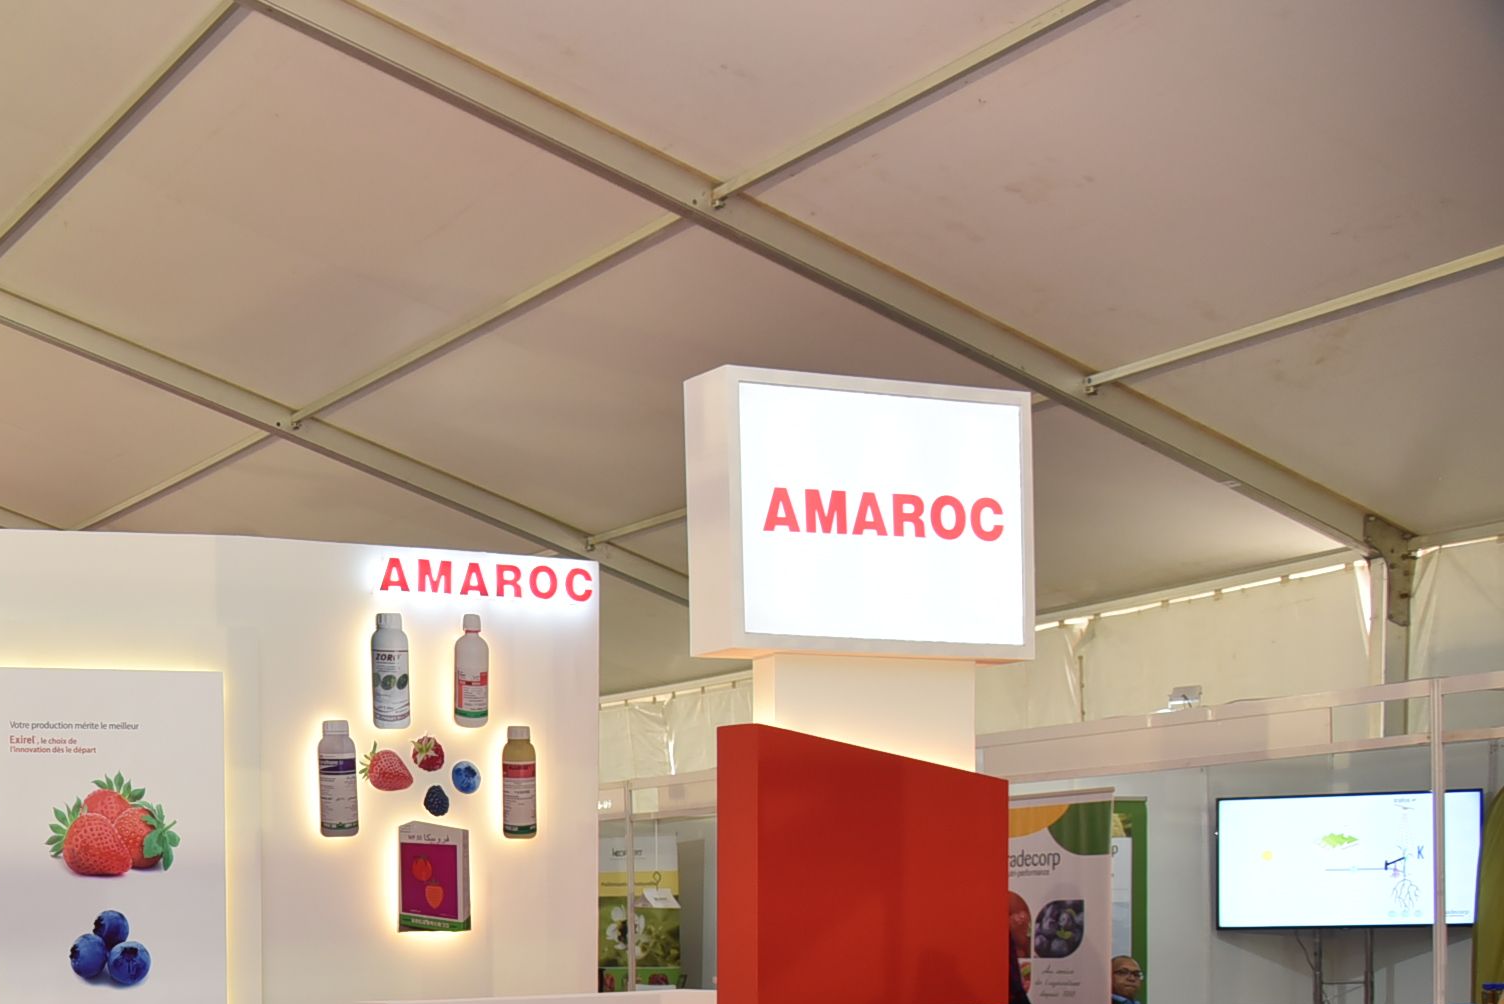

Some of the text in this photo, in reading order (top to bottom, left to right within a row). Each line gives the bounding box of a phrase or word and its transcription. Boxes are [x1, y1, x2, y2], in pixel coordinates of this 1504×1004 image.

[763, 487, 1004, 542] AMAROC
[380, 556, 594, 603] AMAROC
[376, 653, 401, 662] ZOR
[9, 720, 139, 731] Votre production mérite le meilleur
[48, 737, 67, 745] choix
[68, 737, 77, 745] de
[9, 745, 51, 754] l'innovation
[52, 746, 64, 754] dès
[73, 746, 97, 755] départ
